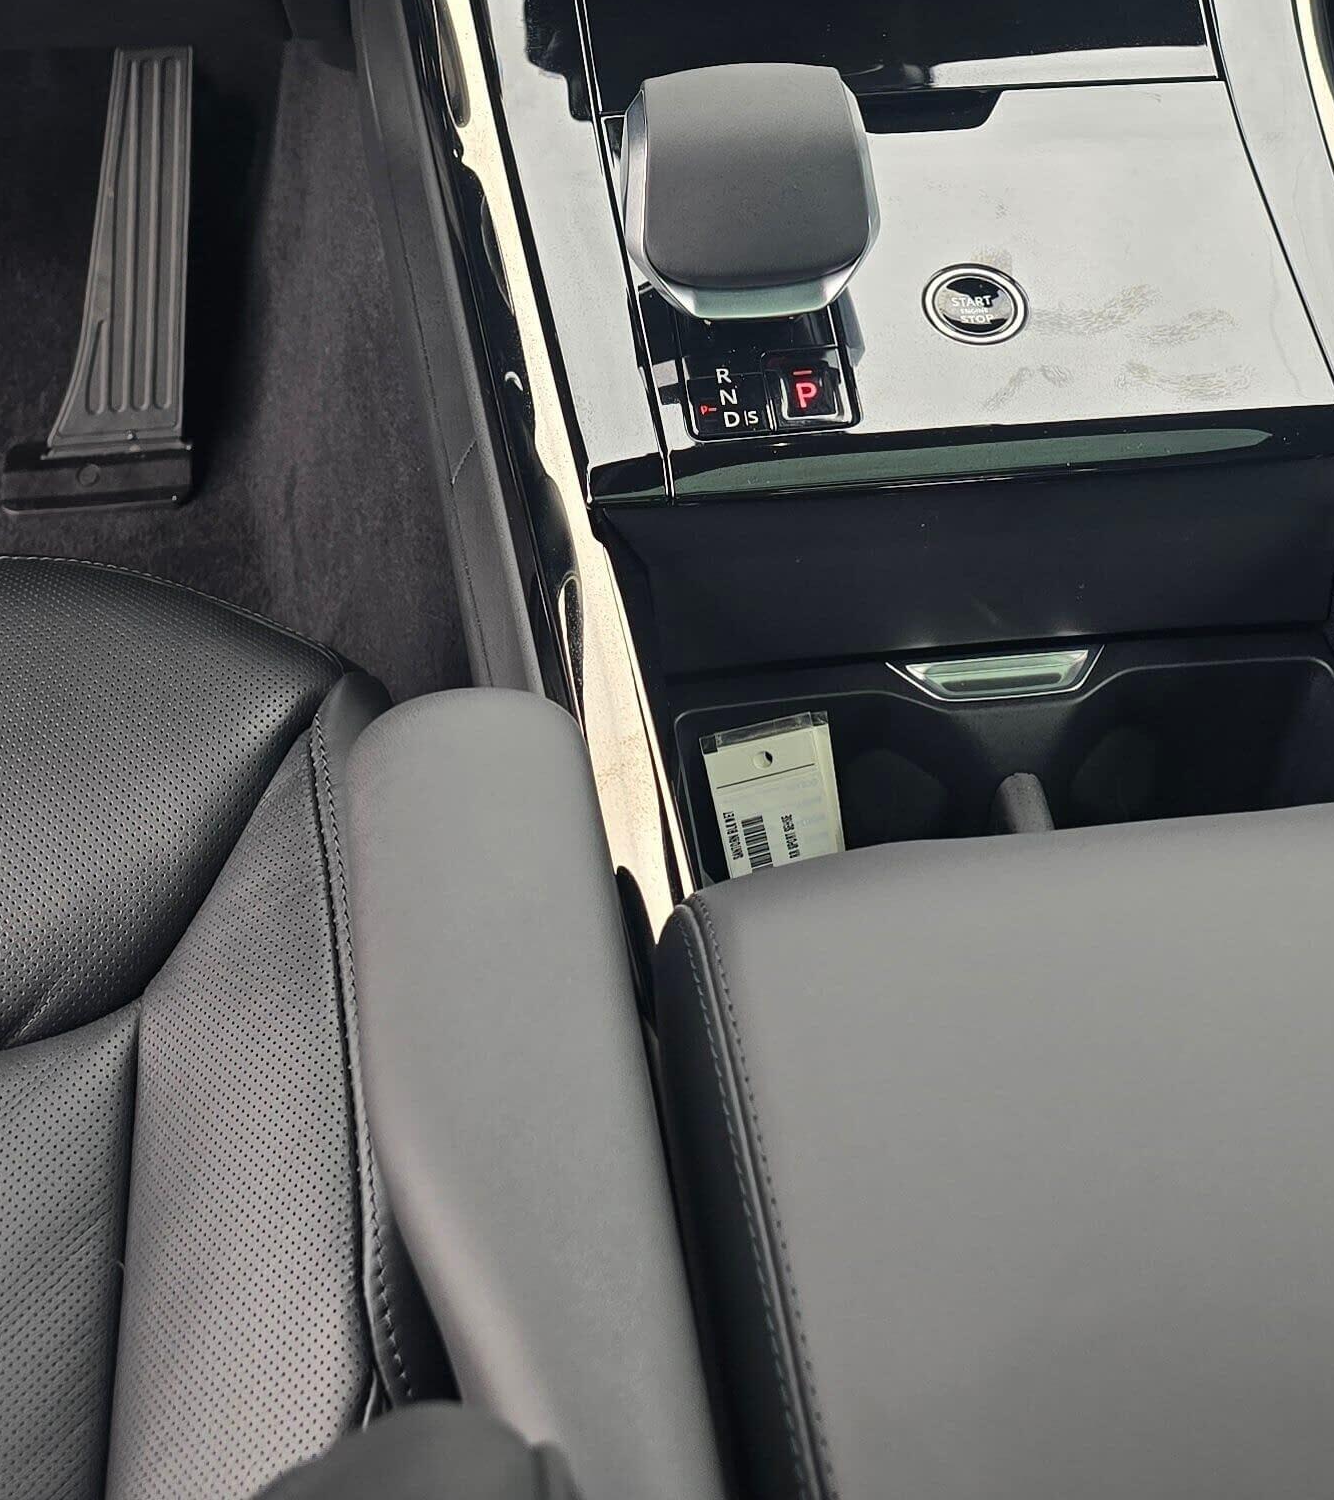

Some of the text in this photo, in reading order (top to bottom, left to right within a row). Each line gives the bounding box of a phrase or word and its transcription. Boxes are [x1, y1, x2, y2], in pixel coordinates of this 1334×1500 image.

[950, 294, 993, 308] START
[960, 314, 995, 324] STOP
[715, 367, 731, 384] R
[719, 388, 738, 405] N
[796, 382, 817, 408] P
